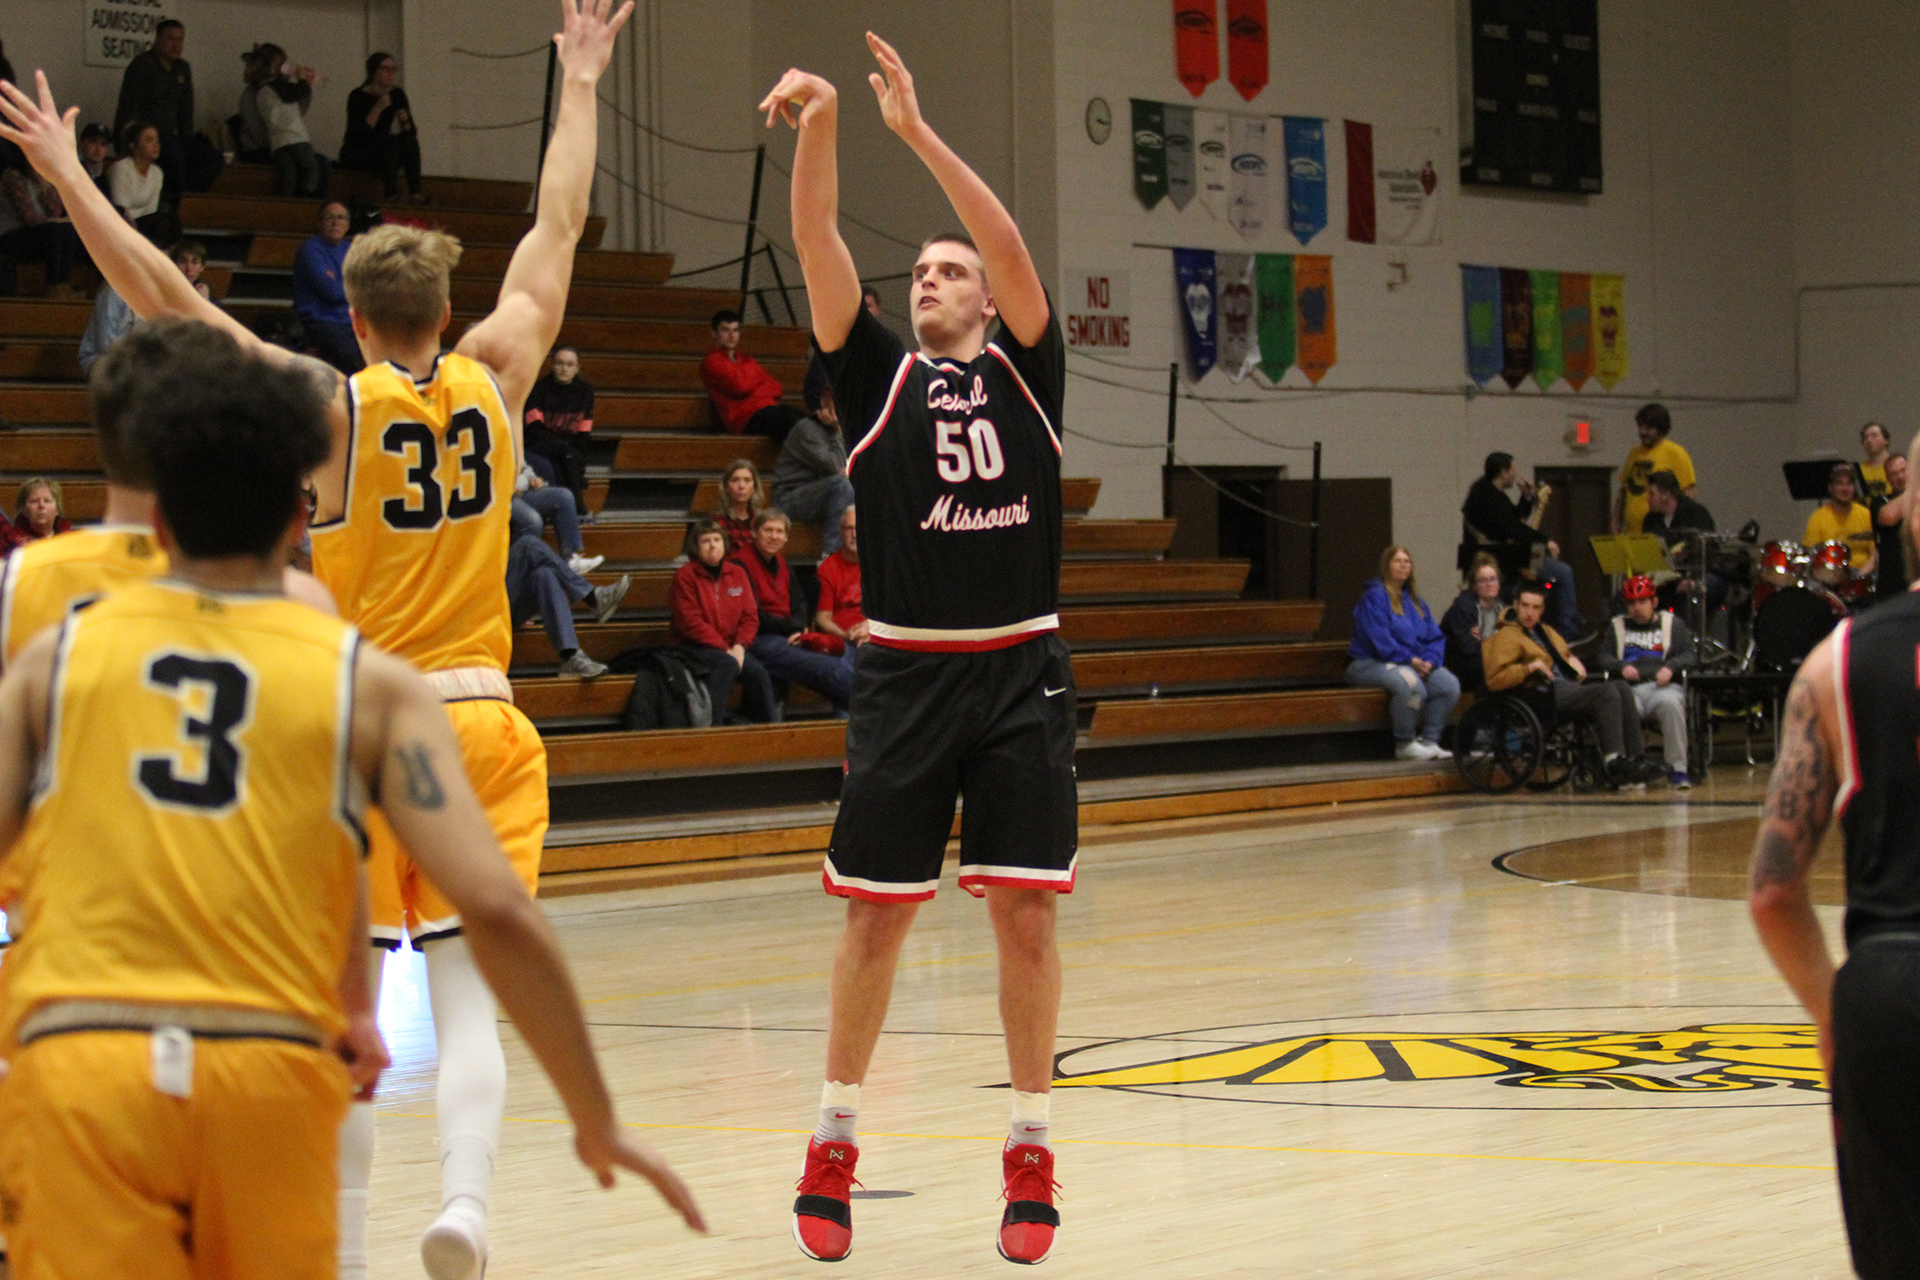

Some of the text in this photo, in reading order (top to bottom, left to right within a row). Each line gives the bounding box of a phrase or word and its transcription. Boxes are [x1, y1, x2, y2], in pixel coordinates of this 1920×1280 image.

[1087, 276, 1110, 309] NO
[1068, 314, 1130, 347] SMOKING
[380, 407, 496, 532] 33
[935, 418, 1005, 483] 50
[920, 494, 1030, 532] Missouri
[133, 647, 258, 819] 3
